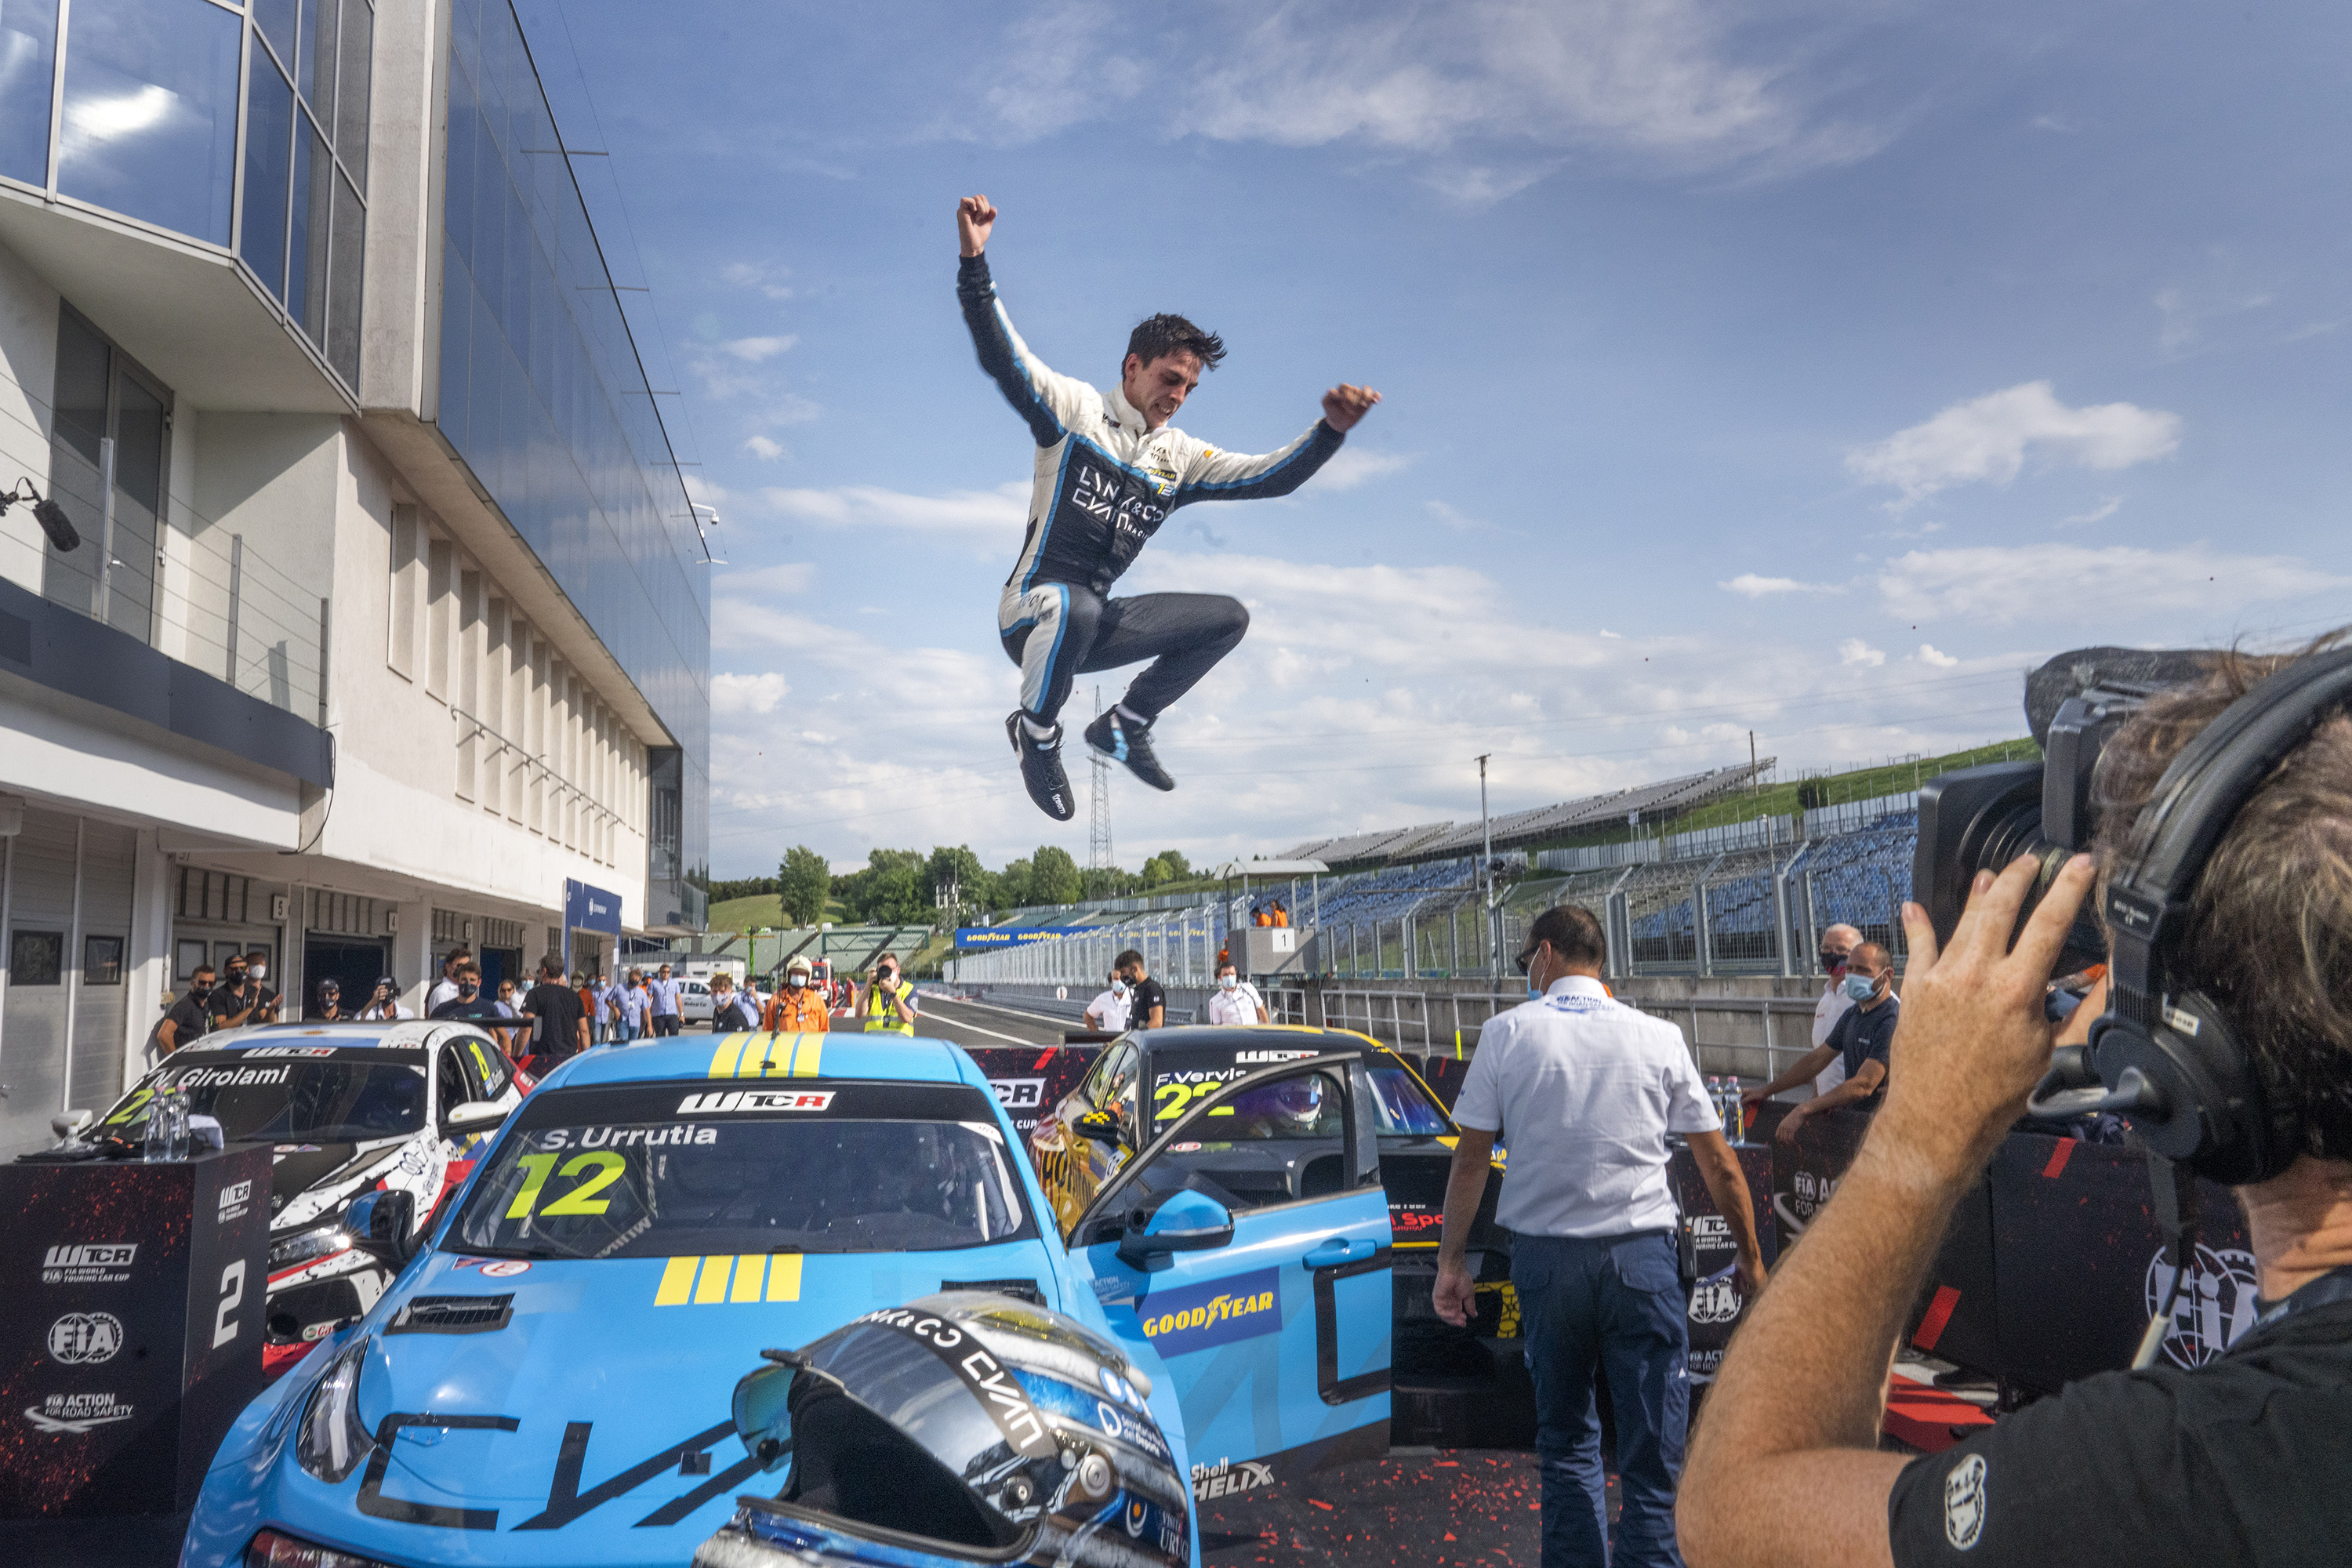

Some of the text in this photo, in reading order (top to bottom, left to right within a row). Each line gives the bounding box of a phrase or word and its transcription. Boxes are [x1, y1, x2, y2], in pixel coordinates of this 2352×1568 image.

[1157, 483, 1174, 497] 12
[278, 900, 283, 916] 5
[967, 932, 1011, 942] GOODYEAR
[1018, 931, 1061, 940] GOODYEAR
[1281, 933, 1287, 947] 1
[178, 1064, 292, 1087] Girolami
[677, 1091, 837, 1113] WTCR
[505, 1150, 626, 1219] 12
[219, 1179, 252, 1210] WTCR
[1795, 1199, 1813, 1216] FOR
[1402, 1212, 1443, 1229] Spo
[1686, 1215, 1731, 1236] WTC
[43, 1243, 138, 1268] WTCR
[64, 1274, 96, 1283] TOURING
[114, 1273, 130, 1282] CUP
[212, 1258, 245, 1350] 2
[1143, 1292, 1273, 1337] GOODYEAR
[1704, 1349, 1724, 1363] ACT
[1702, 1362, 1720, 1371] ROA
[65, 1393, 115, 1407] ACTION
[45, 1404, 134, 1418] FOR ROAD SAFETY
[1191, 1457, 1229, 1482] Shell
[1192, 1461, 1274, 1502] HELIX
[1160, 1526, 1190, 1565] URUG
